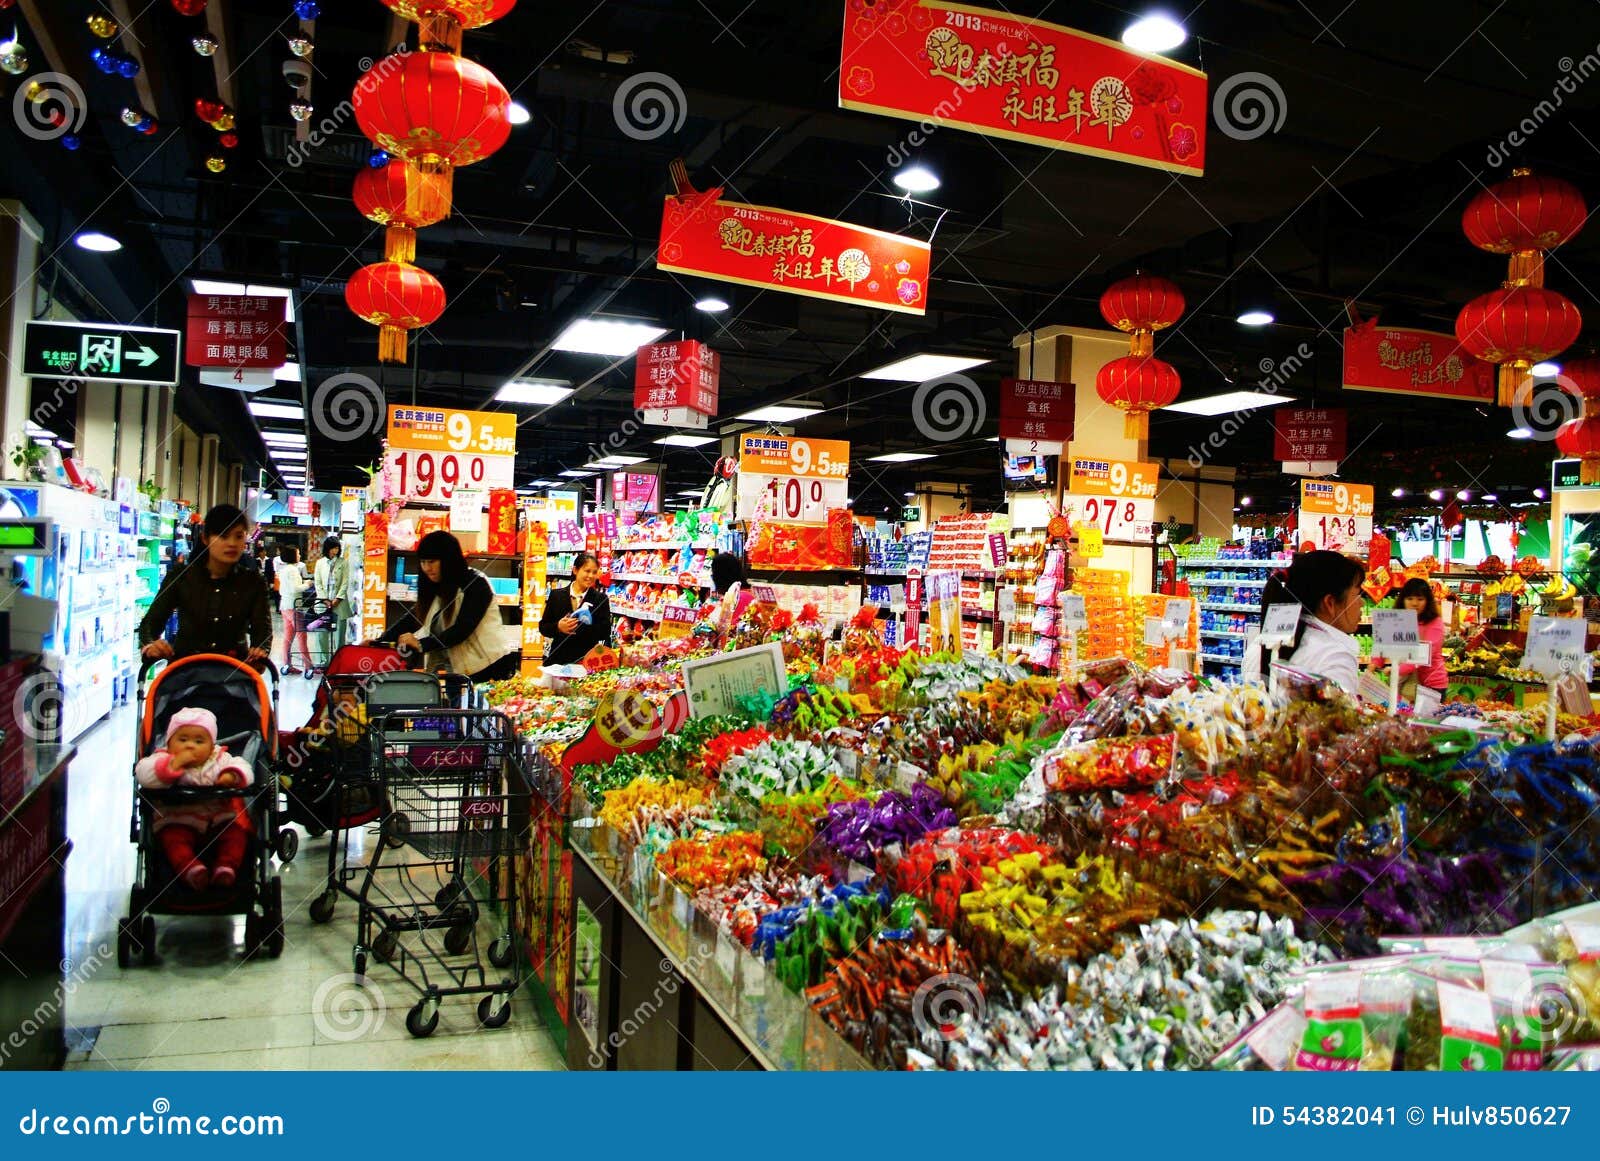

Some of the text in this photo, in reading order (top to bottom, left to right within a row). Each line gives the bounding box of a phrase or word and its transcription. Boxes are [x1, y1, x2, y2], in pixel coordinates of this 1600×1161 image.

[945, 11, 981, 31] 2013
[927, 34, 1060, 89] 迎春接福
[1001, 86, 1128, 143] 永旺年年
[733, 206, 760, 221] 2013
[719, 222, 816, 258] 迎春接福
[772, 256, 865, 293] 永旺年年
[207, 297, 268, 311] 男士护理
[207, 321, 269, 334] 唇膏唇彩
[42, 350, 77, 360] 安全出口
[207, 344, 268, 359] 面膜眼膜
[651, 345, 678, 358] 洗衣粉
[233, 370, 243, 383] 4
[648, 388, 676, 401] 消毒水
[1027, 400, 1050, 413] 盒纸
[395, 410, 444, 422] 会员答谢日
[662, 408, 669, 422] 3
[1024, 421, 1046, 433] 卷纸
[1288, 429, 1333, 439] 卫生护垫
[745, 438, 788, 449] 会员答谢日
[1030, 440, 1038, 452] 2
[768, 477, 822, 518] 10.0
